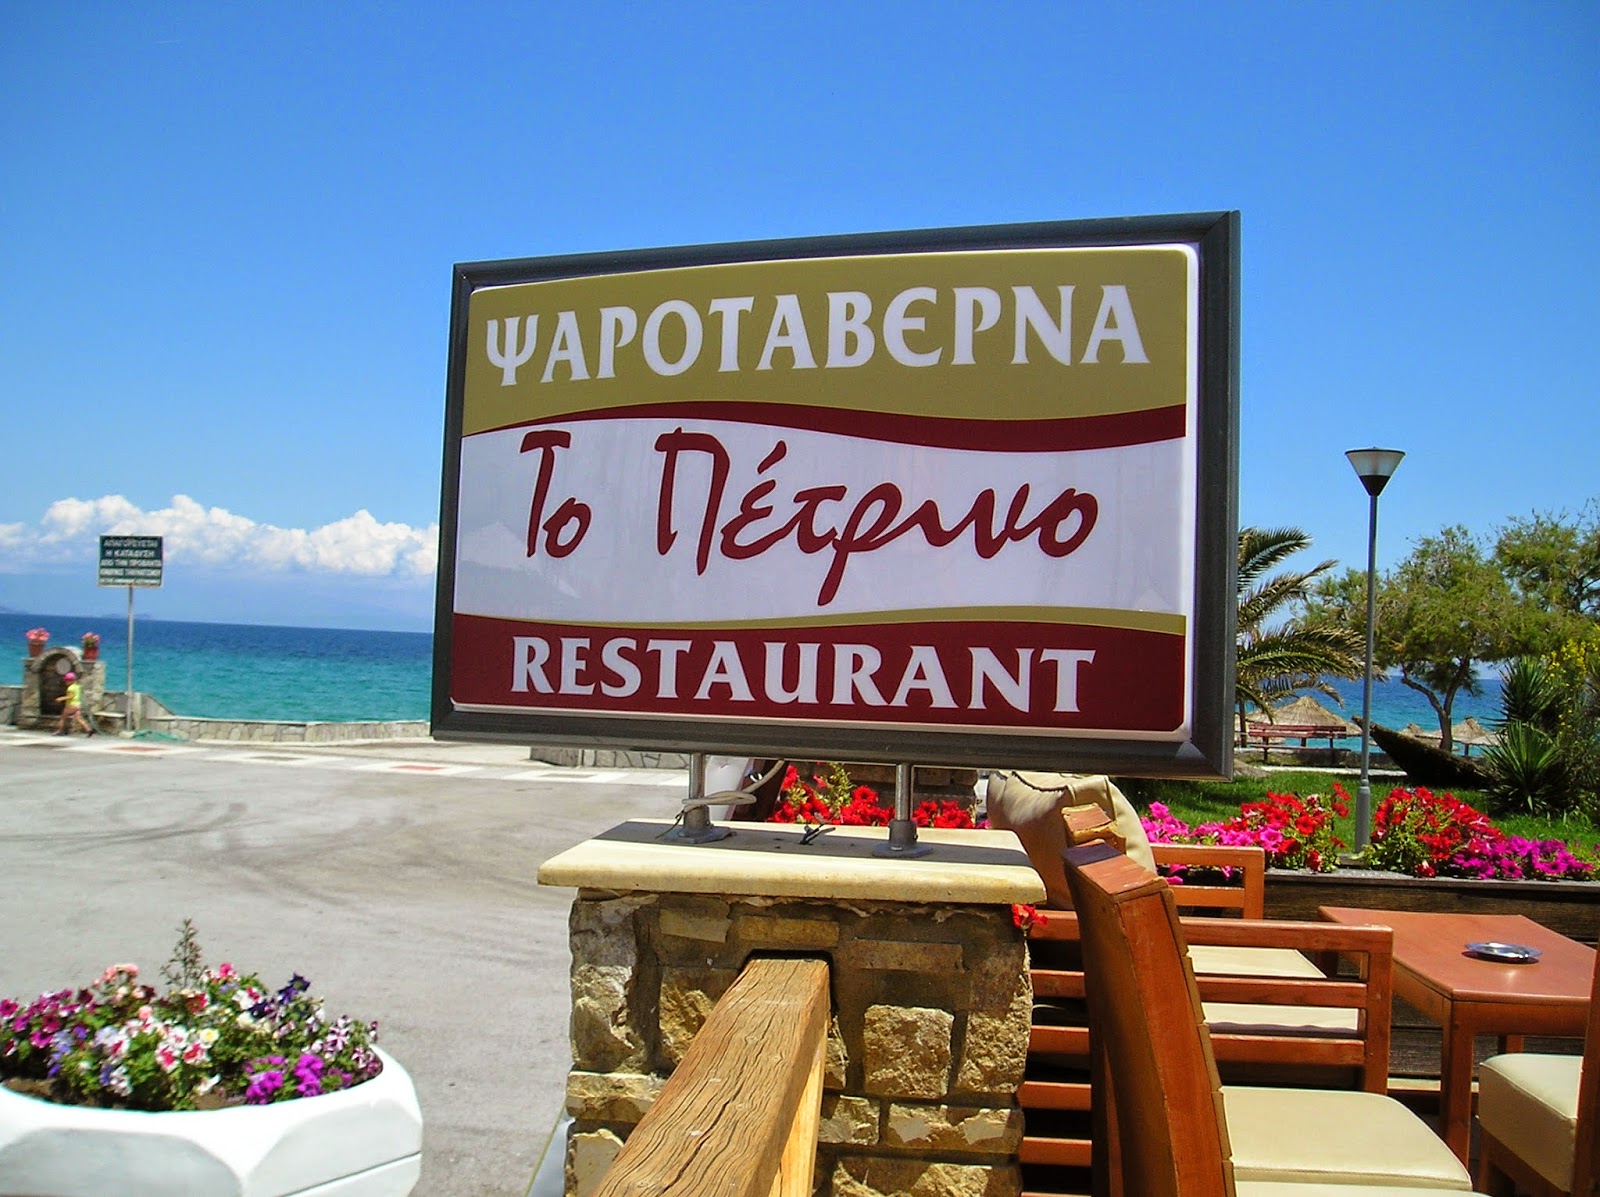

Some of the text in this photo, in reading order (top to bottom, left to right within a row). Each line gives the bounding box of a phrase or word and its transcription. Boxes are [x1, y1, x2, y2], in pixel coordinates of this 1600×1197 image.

[486, 285, 1149, 386] ΨΑΡΟΤΑΒΕΡΝΑ
[520, 426, 1099, 607] Το Πέτρινο
[511, 637, 1096, 713] RESTAURANT
